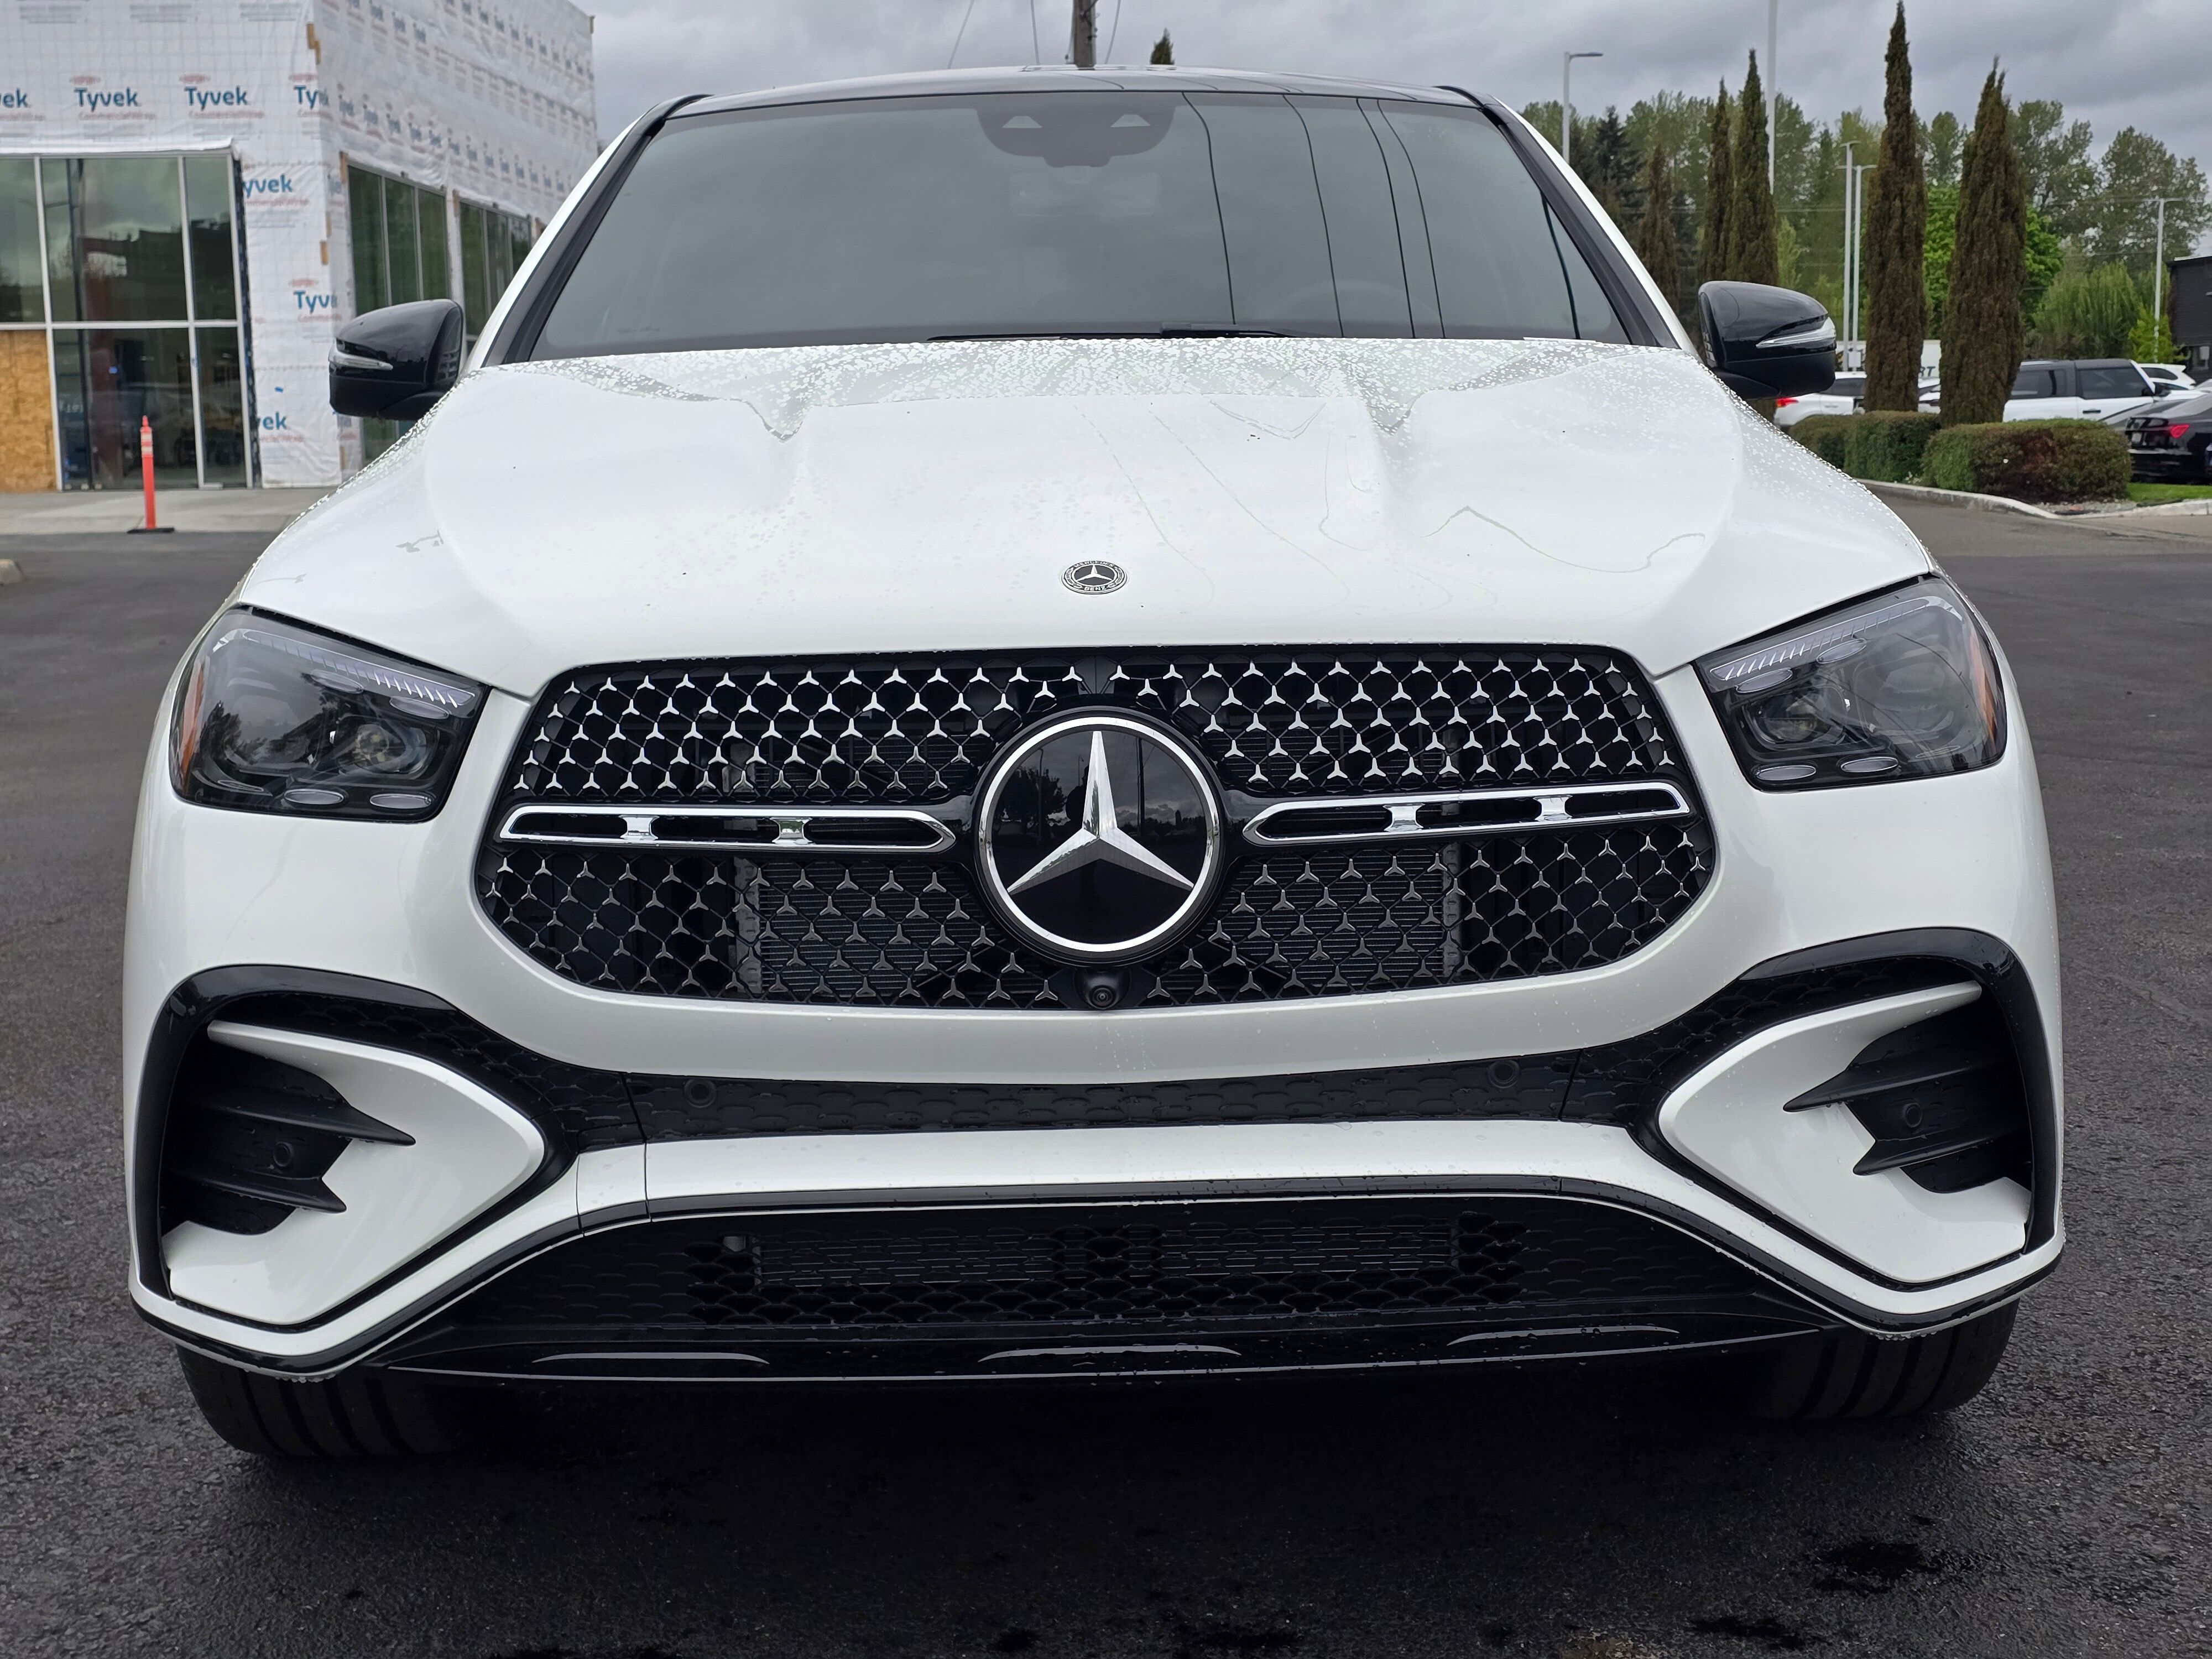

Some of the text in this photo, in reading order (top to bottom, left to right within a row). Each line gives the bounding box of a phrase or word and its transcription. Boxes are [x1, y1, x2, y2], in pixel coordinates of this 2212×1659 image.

[0, 87, 28, 108] ek
[74, 86, 138, 112] Tyvek
[184, 85, 248, 111] Tyvek
